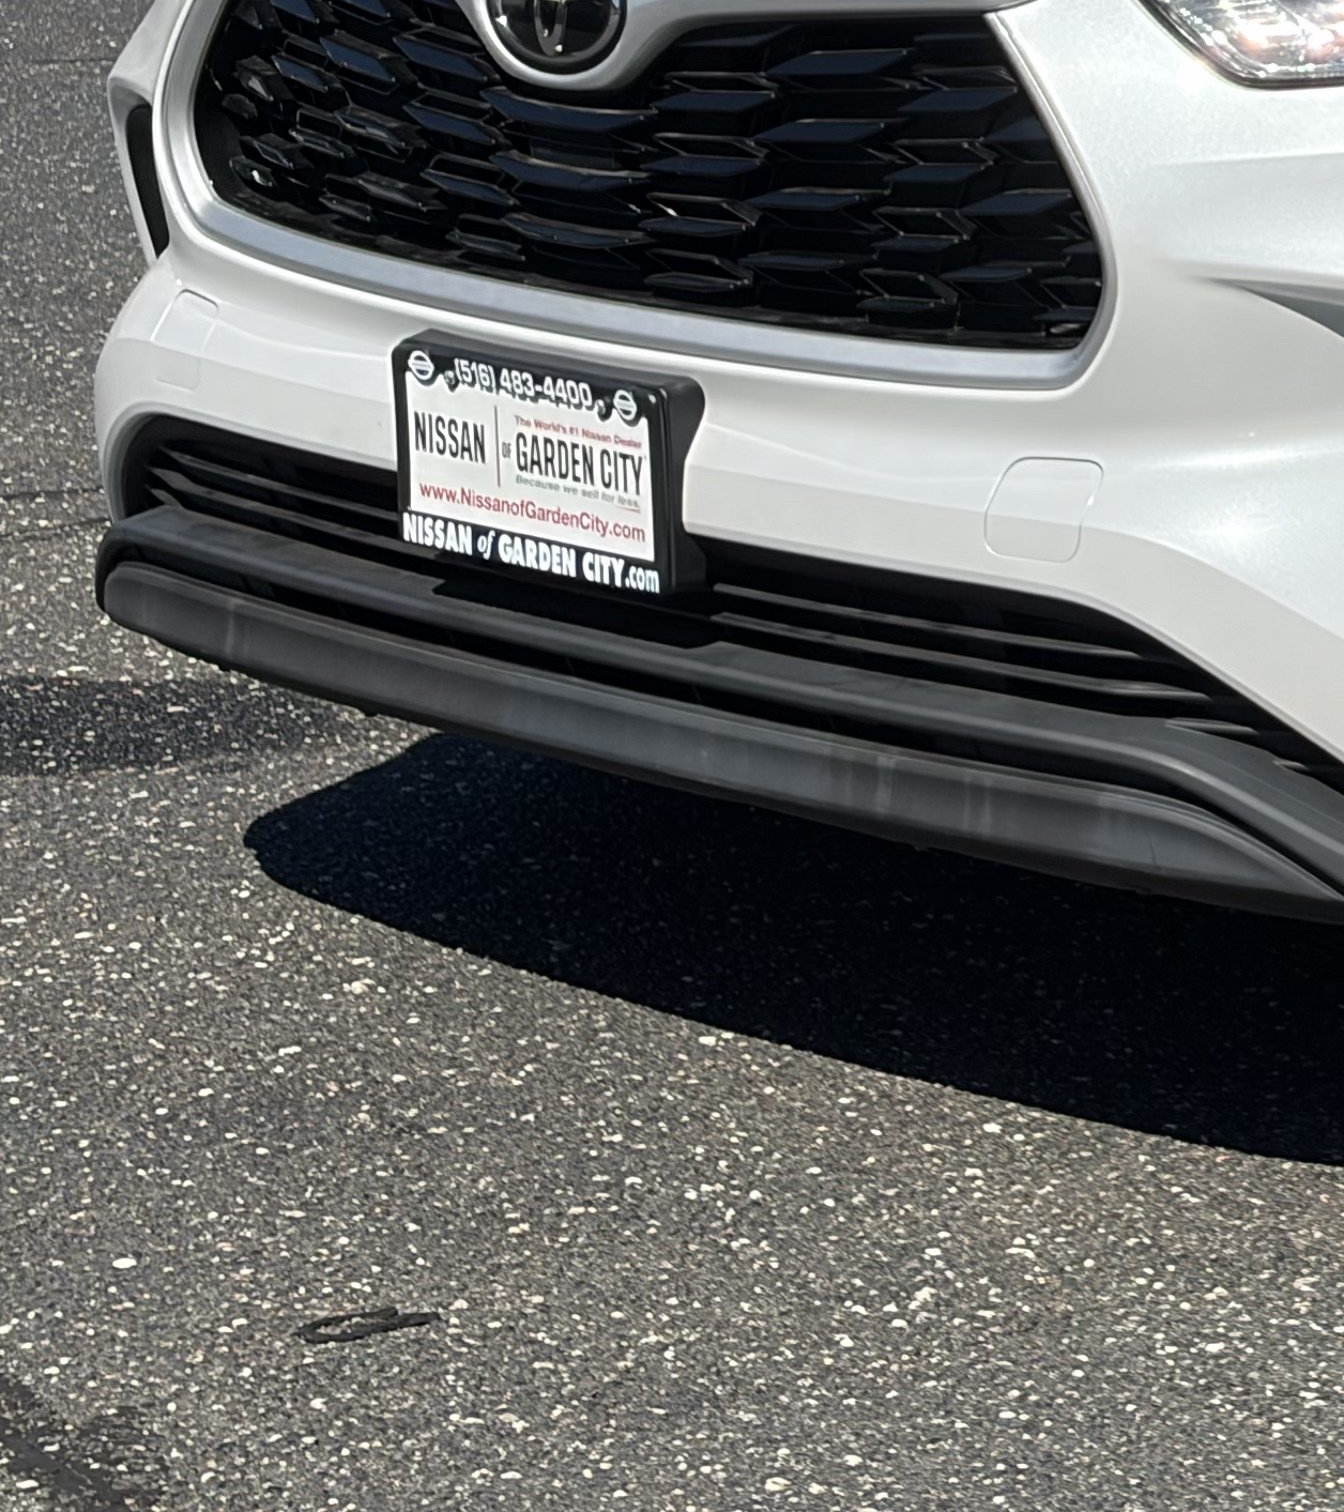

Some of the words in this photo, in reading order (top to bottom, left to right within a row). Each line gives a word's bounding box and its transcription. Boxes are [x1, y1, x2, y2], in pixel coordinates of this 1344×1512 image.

[454, 357, 496, 395] (516)
[500, 368, 593, 407] 483-4400
[414, 411, 486, 464] NISSAN
[514, 414, 531, 428] The
[582, 427, 612, 443] Nissan
[614, 433, 642, 449] Dealer
[502, 441, 512, 460] OF
[516, 431, 595, 487] GARDEN
[600, 449, 642, 496] CITY
[515, 474, 560, 492] Because
[563, 484, 579, 496] we
[582, 488, 600, 500] sell
[602, 490, 615, 504] for
[419, 482, 647, 544] www.NissanofGardenCity.com
[402, 510, 473, 557] NISSAN
[477, 530, 497, 561] of
[498, 533, 577, 579] GARDEN
[583, 551, 661, 594] CITY.com
